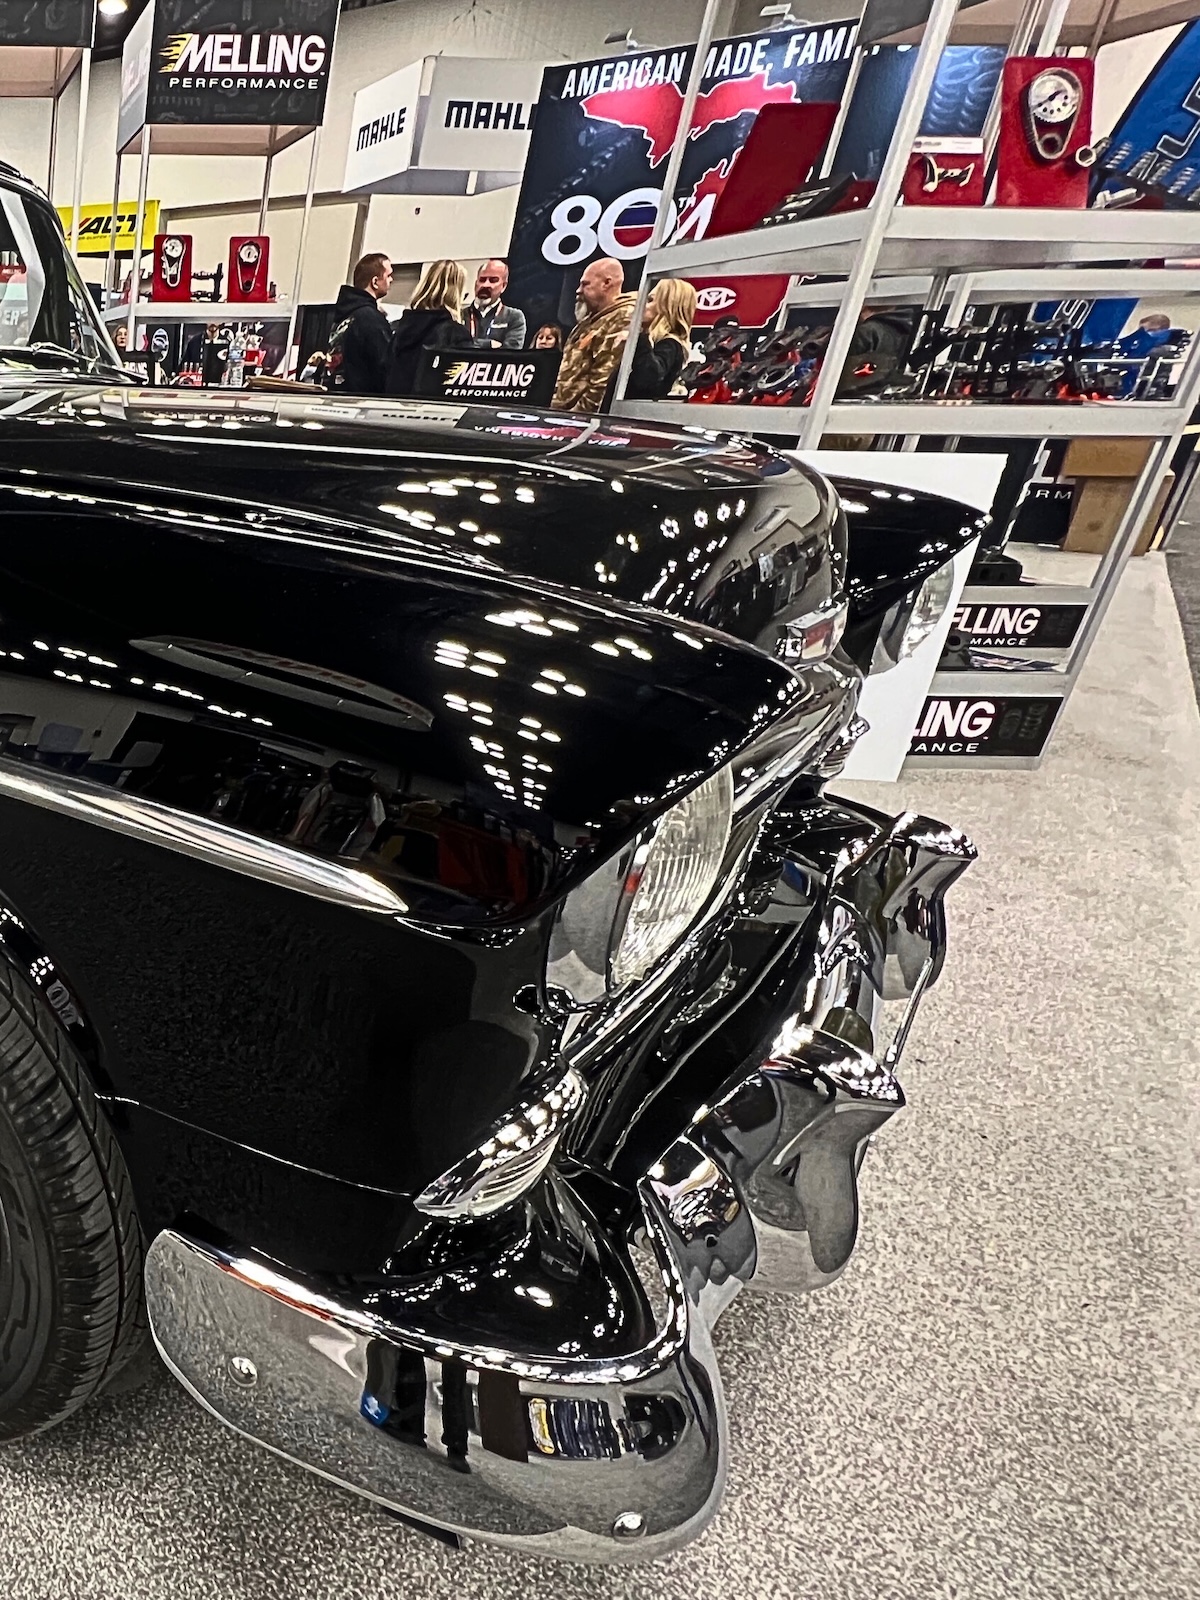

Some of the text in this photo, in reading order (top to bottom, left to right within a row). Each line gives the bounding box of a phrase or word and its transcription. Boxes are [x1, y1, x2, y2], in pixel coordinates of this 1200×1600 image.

[172, 33, 326, 74] MELLING
[561, 52, 687, 99] AMERICAN
[783, 25, 880, 68] FAMI
[169, 77, 318, 89] PERFORMANCE
[356, 106, 407, 152] MAHLE
[452, 362, 536, 387] MELLING
[445, 388, 528, 398] PERFORMANCE
[909, 742, 980, 753] ANCE
